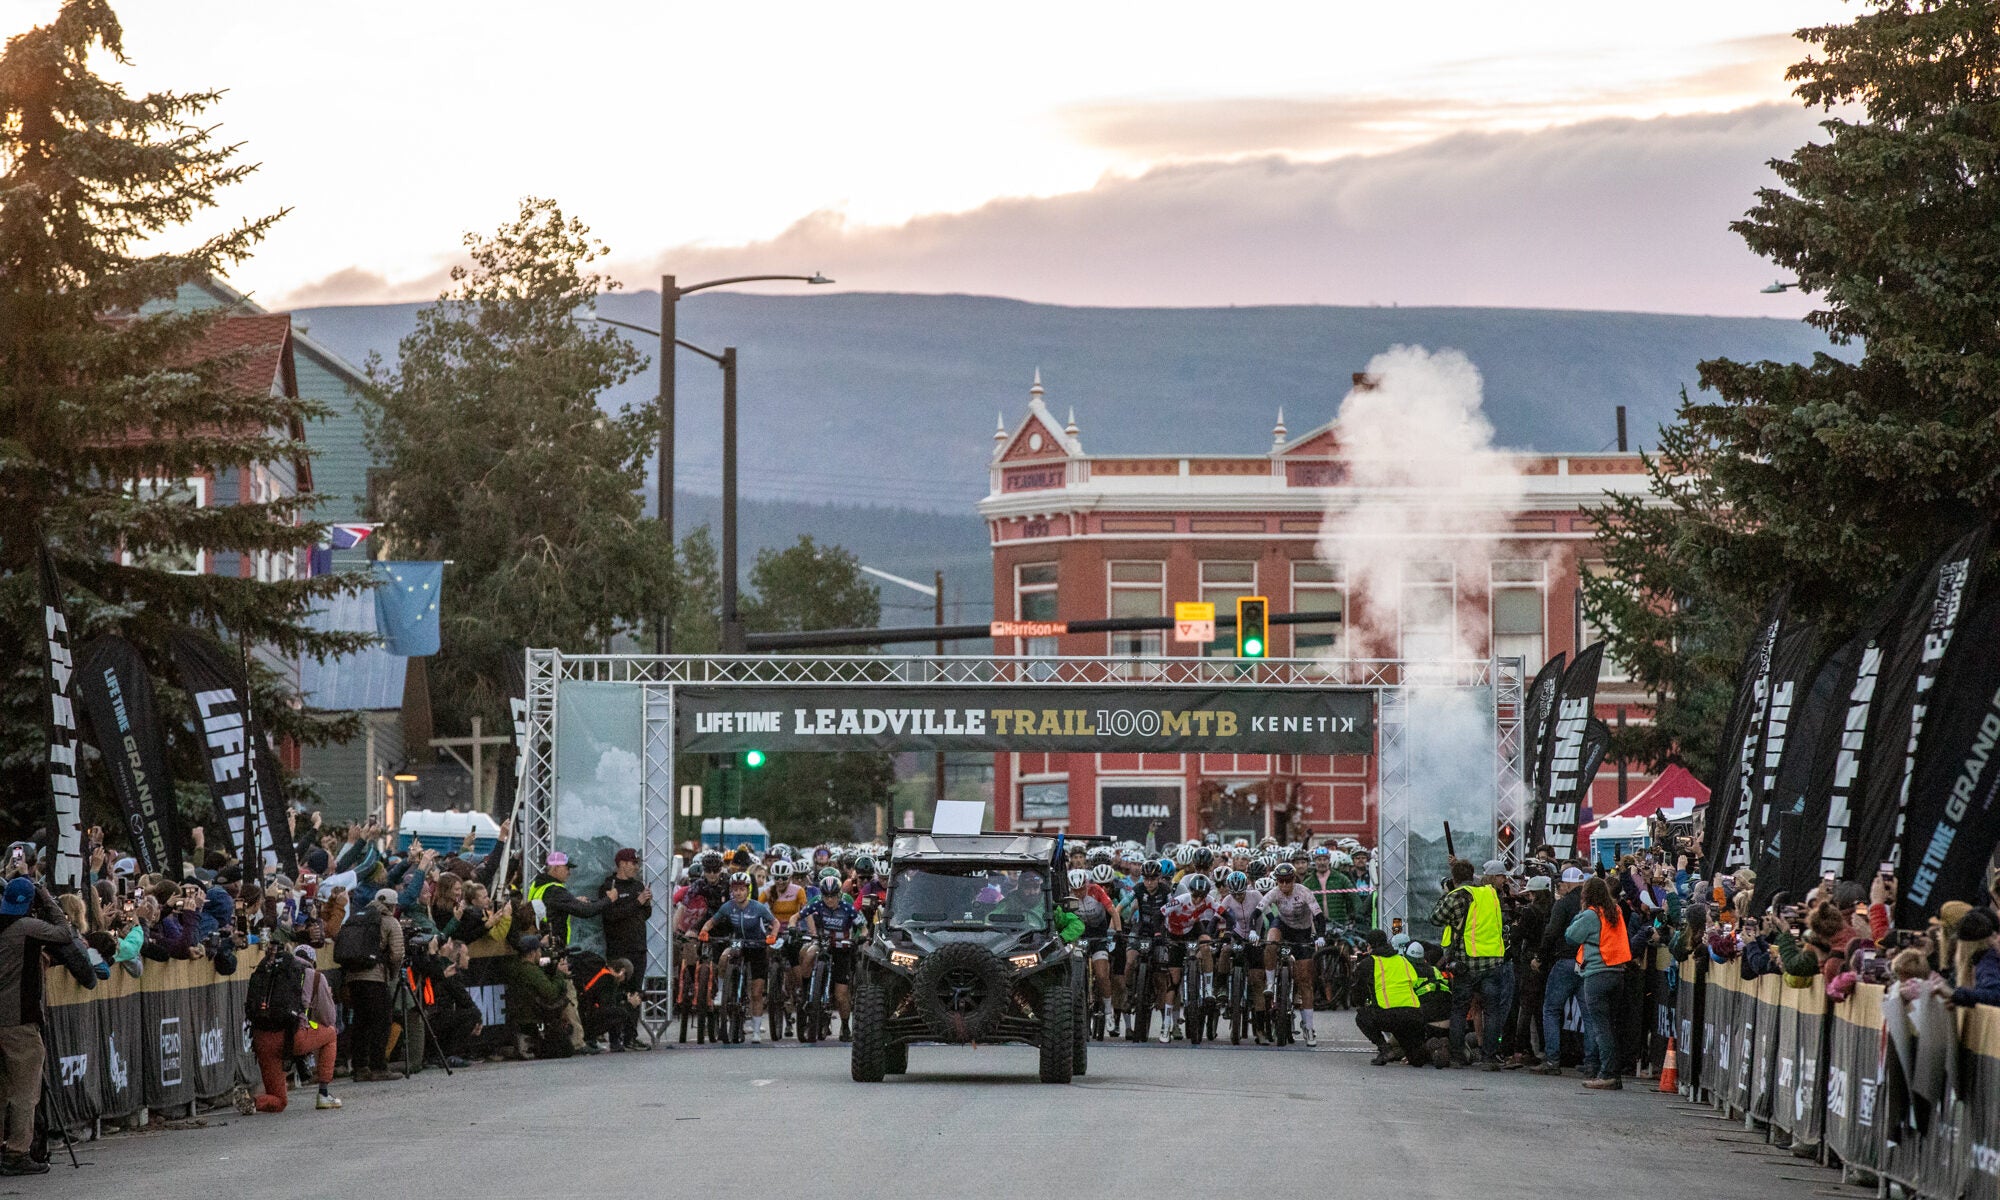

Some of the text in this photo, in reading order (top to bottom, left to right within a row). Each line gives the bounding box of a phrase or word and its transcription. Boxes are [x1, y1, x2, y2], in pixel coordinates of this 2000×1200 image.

[1004, 621, 1067, 636] Harrison Ave
[194, 688, 245, 784] LIFE
[696, 712, 733, 733] LIFE
[734, 711, 781, 733] TIME
[794, 708, 986, 735] LEADVILLE
[103, 667, 171, 875] LIFE TIME GRAND PRIX
[1543, 696, 1589, 861] IFE TIME
[1945, 712, 2000, 823] GRAND
[1111, 804, 1171, 818] GALENA
[137, 834, 153, 874] mazd
[1922, 820, 1957, 871] TIME
[1906, 864, 1939, 907] LIFE
